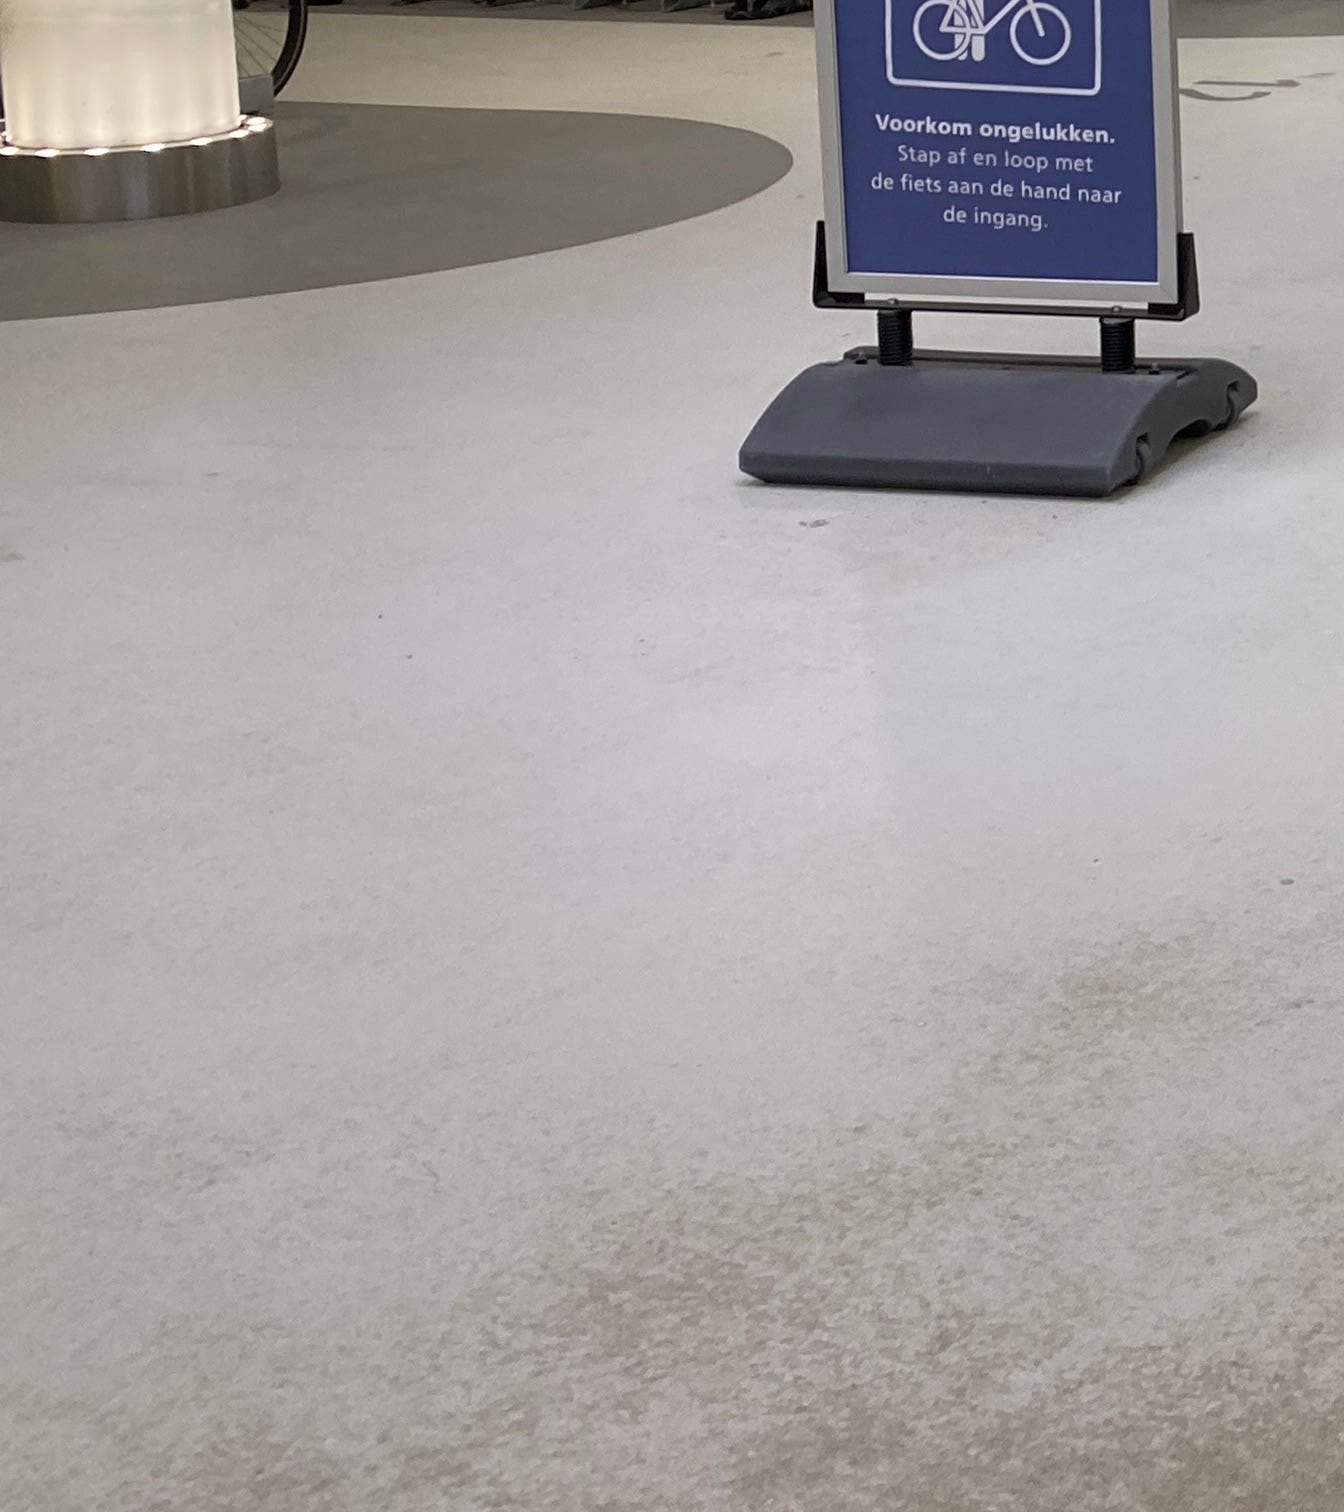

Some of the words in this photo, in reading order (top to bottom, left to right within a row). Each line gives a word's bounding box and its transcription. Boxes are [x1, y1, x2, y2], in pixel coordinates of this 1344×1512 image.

[875, 114, 972, 136] Voorkom
[979, 122, 1115, 144] ongelukken.
[898, 145, 941, 167] Stap
[947, 148, 967, 165] af
[973, 152, 997, 167] en
[1004, 150, 1049, 173] loop
[1055, 156, 1093, 173] met
[871, 172, 894, 190] de
[900, 173, 942, 193] fiets
[948, 180, 983, 195] aan
[990, 179, 1014, 197] de
[1021, 180, 1071, 201] hand
[1077, 188, 1122, 204] naar
[943, 205, 967, 224] de
[974, 207, 1049, 232] ingang.
